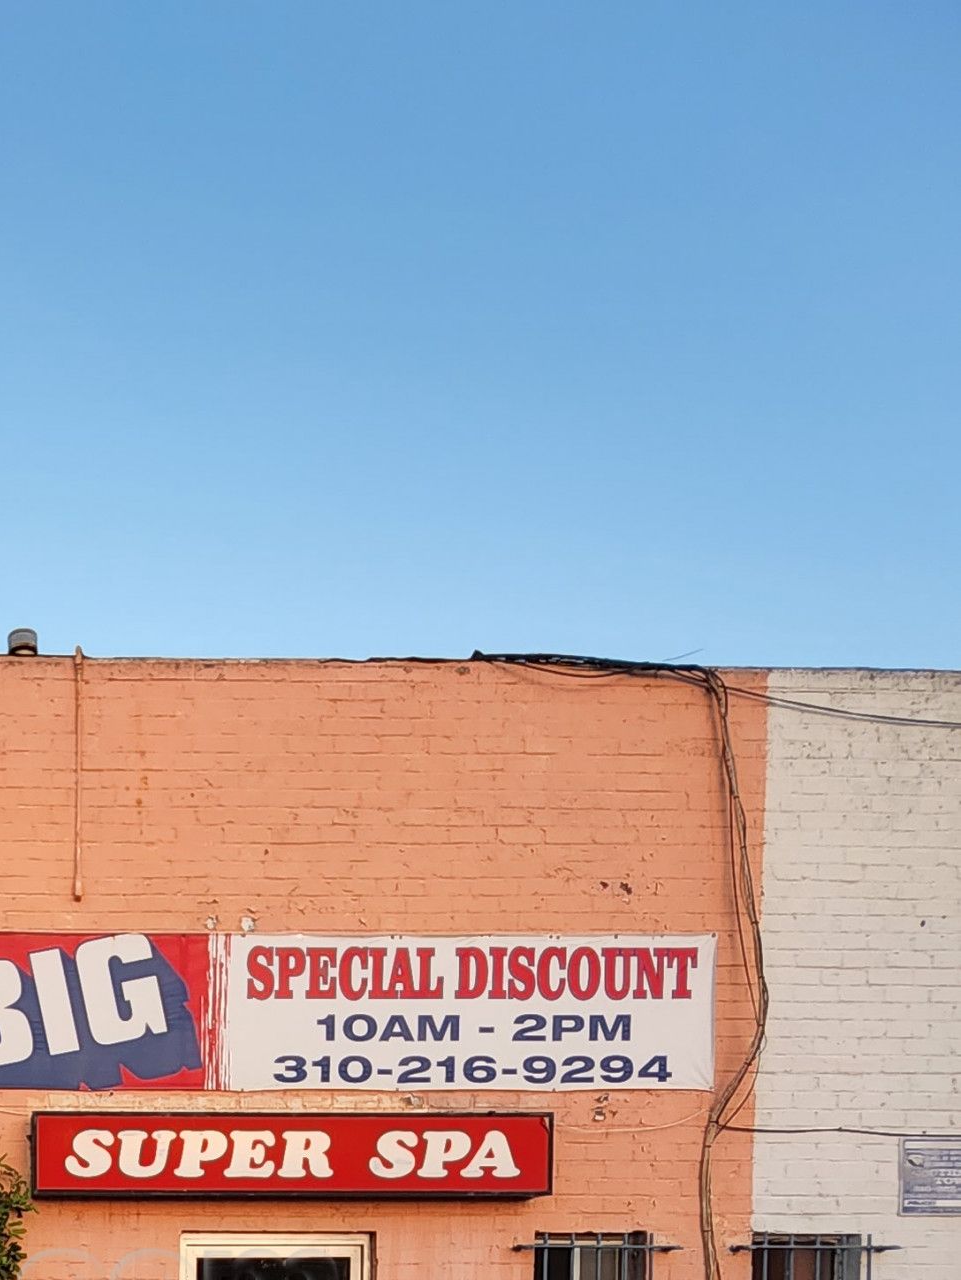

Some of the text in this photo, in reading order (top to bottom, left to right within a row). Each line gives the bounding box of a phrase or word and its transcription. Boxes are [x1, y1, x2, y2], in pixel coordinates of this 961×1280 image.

[246, 945, 699, 1001] SPECIAL DISCOUNT
[316, 1012, 461, 1043] 10AM
[512, 1012, 632, 1042] 2PM
[272, 1054, 673, 1084] 310-216-9294
[63, 1128, 522, 1179] SUPER SPA
